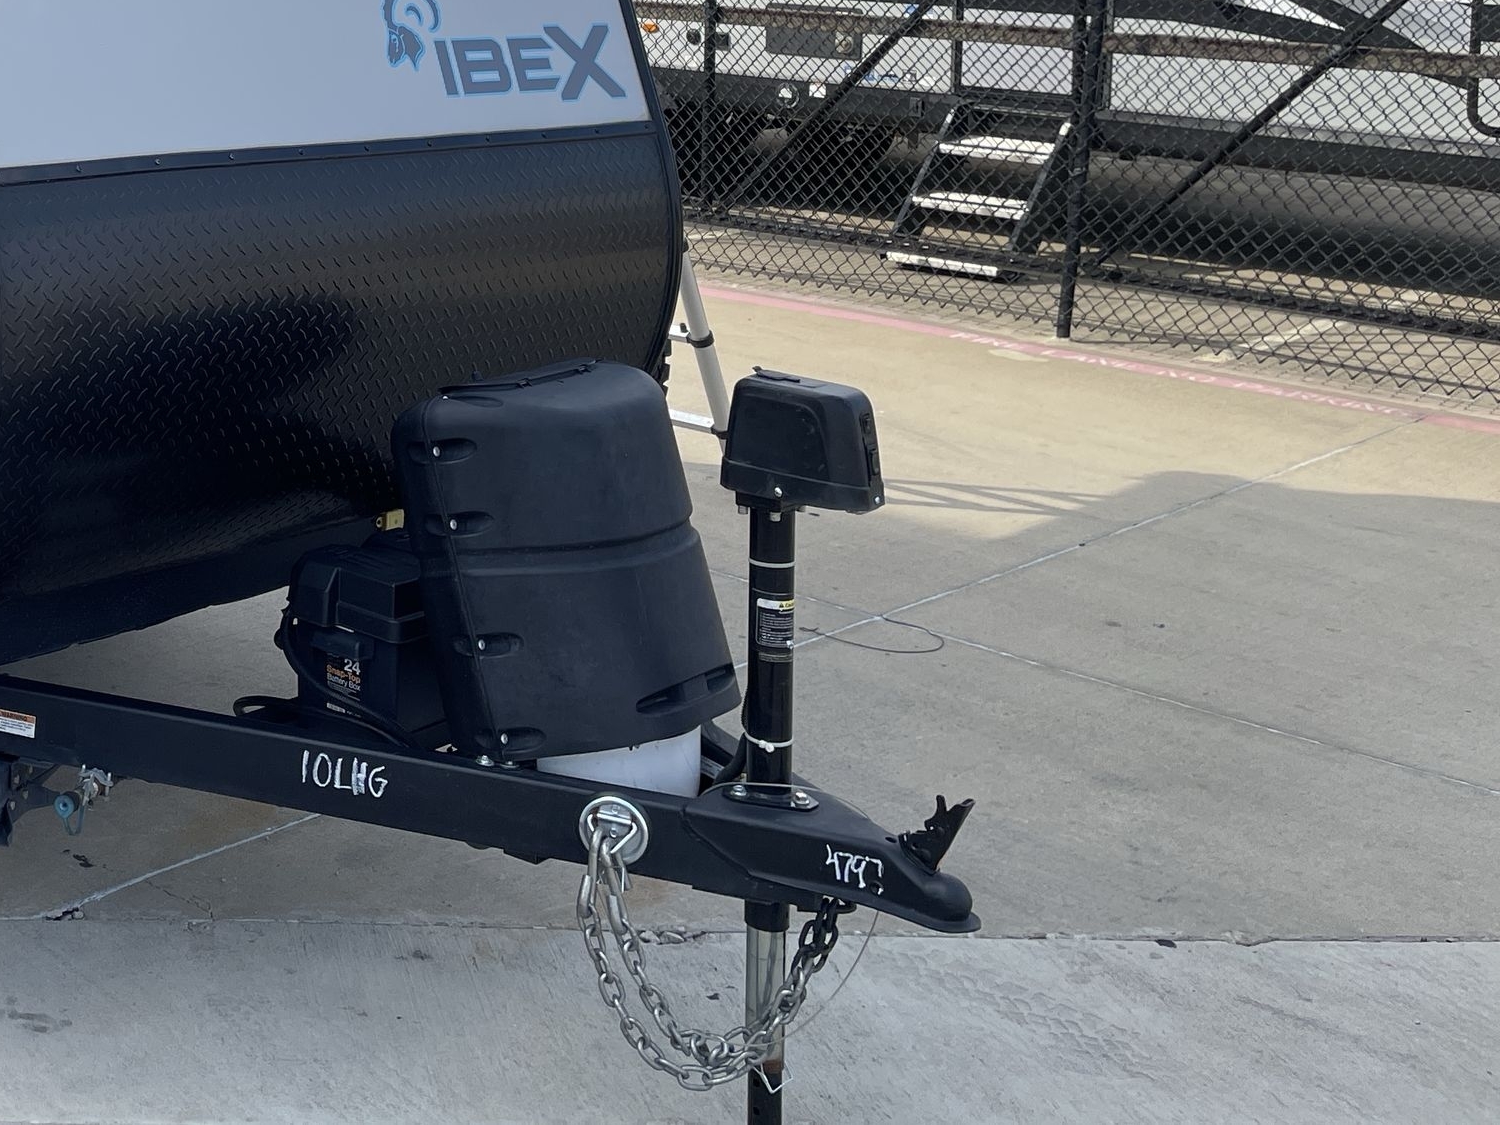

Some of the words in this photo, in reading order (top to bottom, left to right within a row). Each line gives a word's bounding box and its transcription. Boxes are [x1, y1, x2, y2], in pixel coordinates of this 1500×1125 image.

[433, 23, 628, 101] IBEX
[326, 664, 361, 684] Snap-Top
[344, 658, 361, 676] 24
[348, 680, 361, 691] Box
